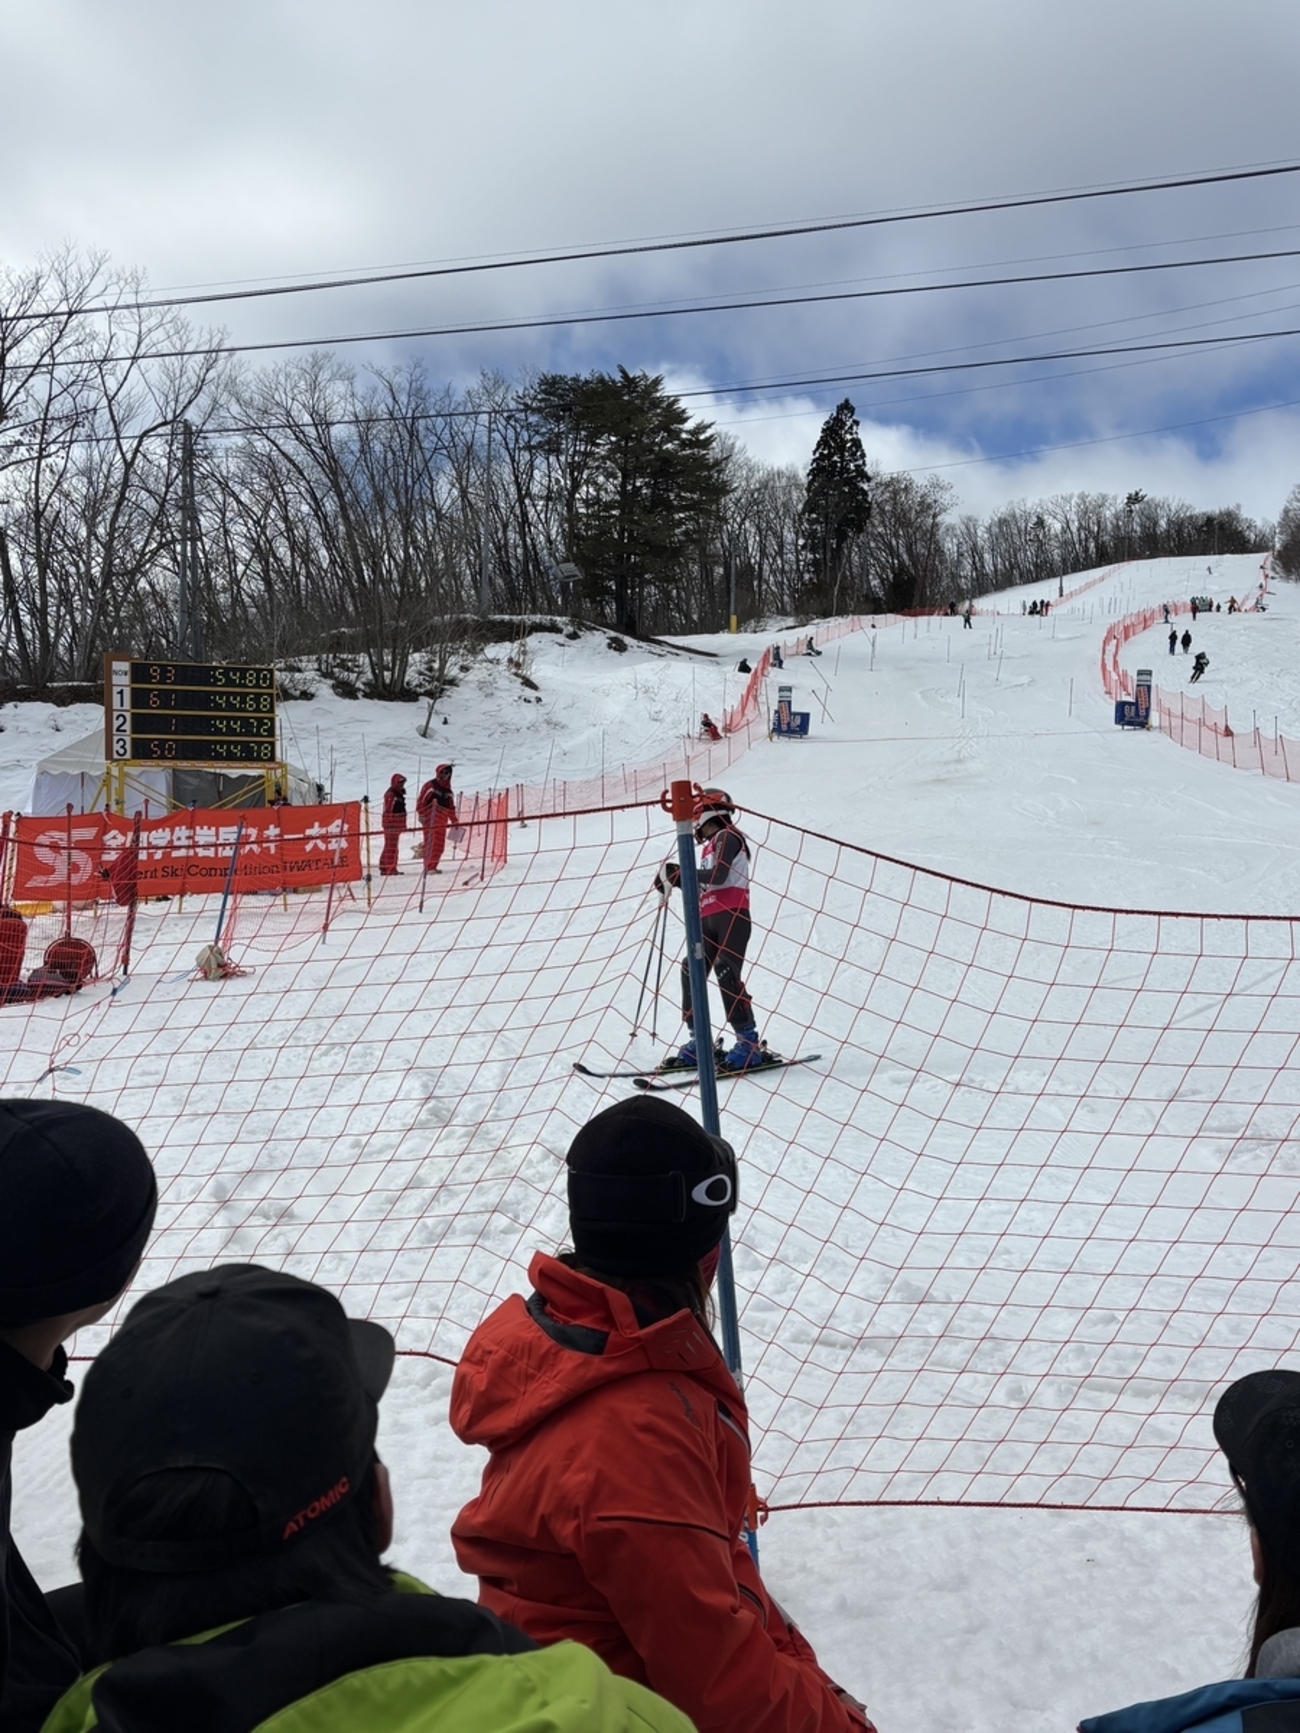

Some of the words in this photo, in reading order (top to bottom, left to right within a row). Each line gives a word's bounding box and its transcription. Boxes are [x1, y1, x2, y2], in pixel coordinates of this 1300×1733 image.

[149, 665, 176, 683] 93
[116, 688, 125, 708] 1
[149, 691, 176, 708] 61
[115, 713, 128, 733] 2
[115, 737, 128, 757] 3
[150, 740, 176, 758] 50
[161, 865, 184, 878] Ski
[282, 1476, 349, 1540] ATOMIC
